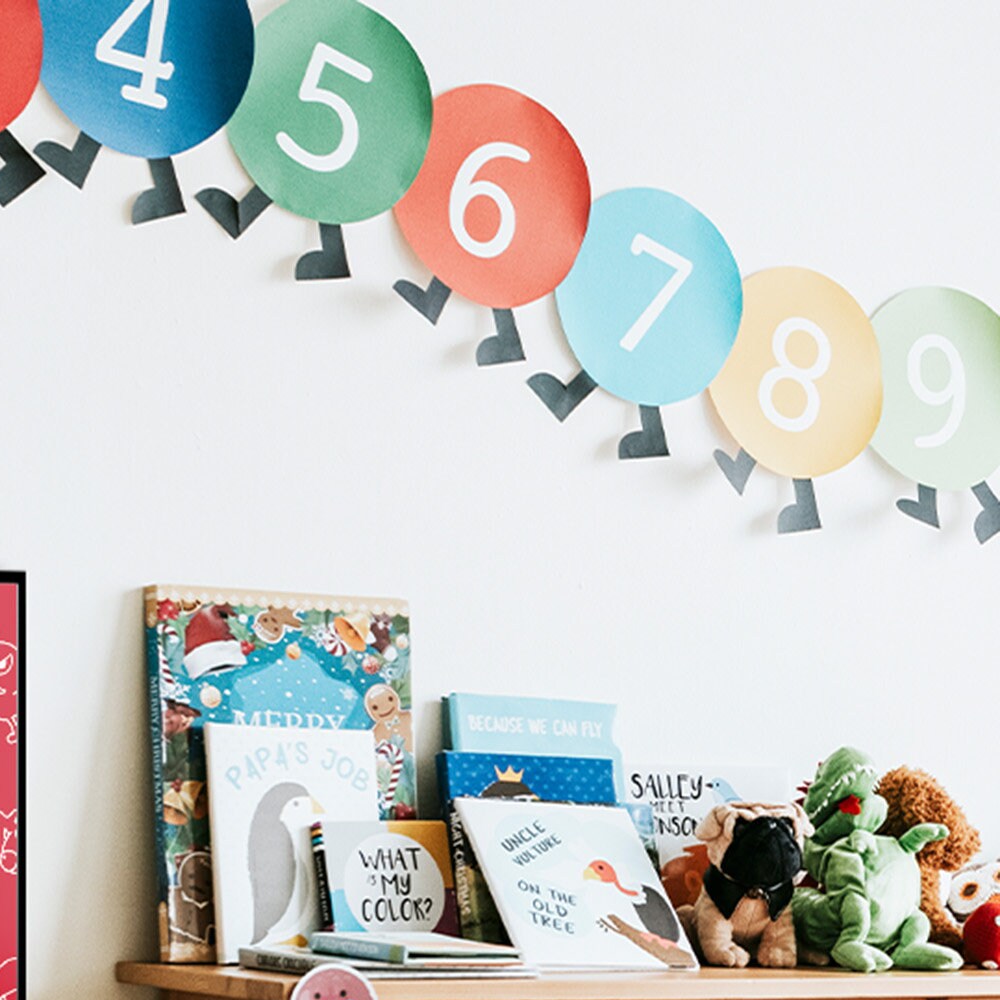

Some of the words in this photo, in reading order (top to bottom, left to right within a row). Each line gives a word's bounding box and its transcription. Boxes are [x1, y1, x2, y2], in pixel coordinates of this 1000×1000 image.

[95, 0, 174, 109] 4
[276, 42, 373, 172] 5
[449, 142, 531, 258] 6
[620, 233, 693, 352] 7
[758, 317, 832, 432] 8
[907, 334, 966, 447] 9
[467, 714, 524, 735] BECAUSE
[527, 718, 548, 736] WE
[553, 719, 578, 738] CAN
[581, 720, 603, 740] FLY
[225, 741, 309, 790] PAPA'S
[320, 747, 370, 792] JOB
[631, 773, 703, 800] SALLEY
[649, 801, 684, 813] MEET
[501, 820, 546, 852] UNCLE
[512, 834, 562, 867] VULTURE
[358, 847, 421, 870] WHAT
[517, 880, 541, 896] ON
[548, 888, 577, 906] THE
[532, 899, 568, 918] OLD
[362, 897, 433, 922] COLOR?
[528, 910, 575, 935] TREE
